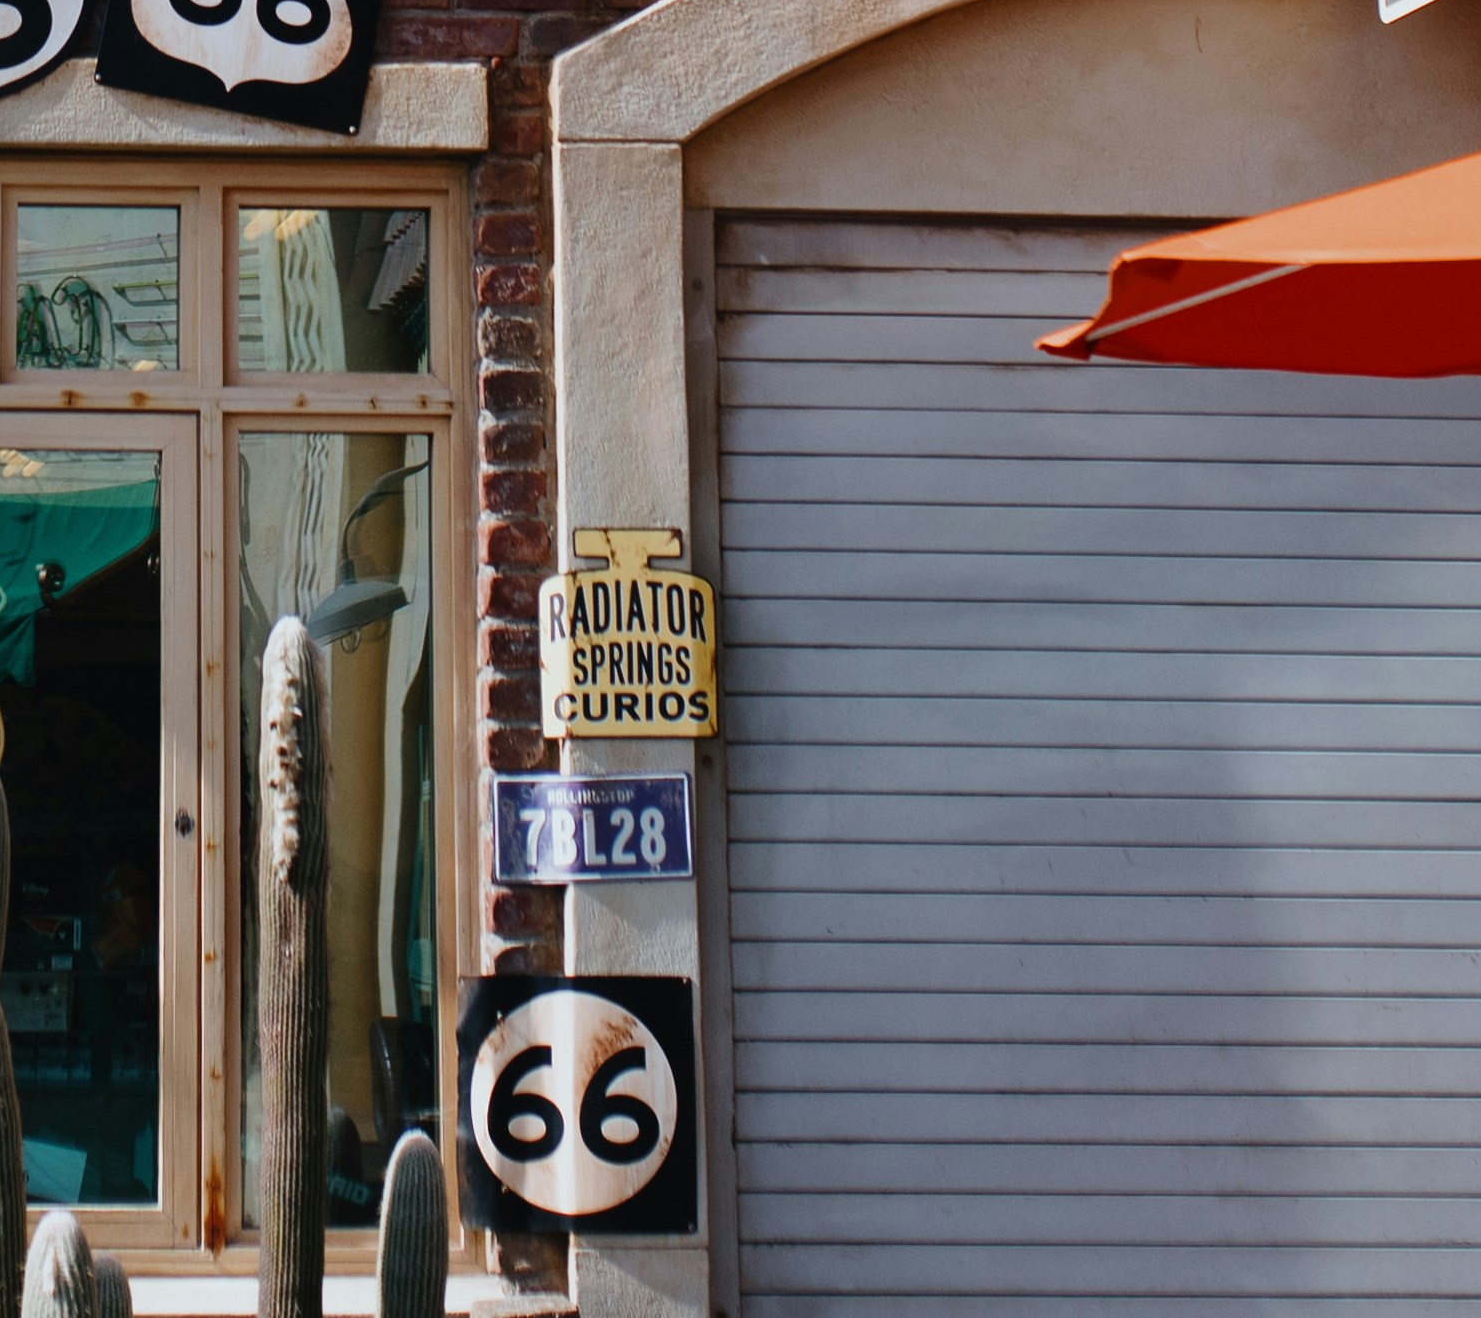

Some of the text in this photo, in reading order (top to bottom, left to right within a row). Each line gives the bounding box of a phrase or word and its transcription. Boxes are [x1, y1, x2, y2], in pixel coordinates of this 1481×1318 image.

[548, 579, 707, 644] RADIATOR
[572, 640, 692, 687] SPRINGS
[553, 689, 711, 723] CURIOS
[546, 787, 635, 805] ROLLINGSTOP
[519, 807, 668, 867] 7BL28
[485, 1045, 664, 1165] 66
